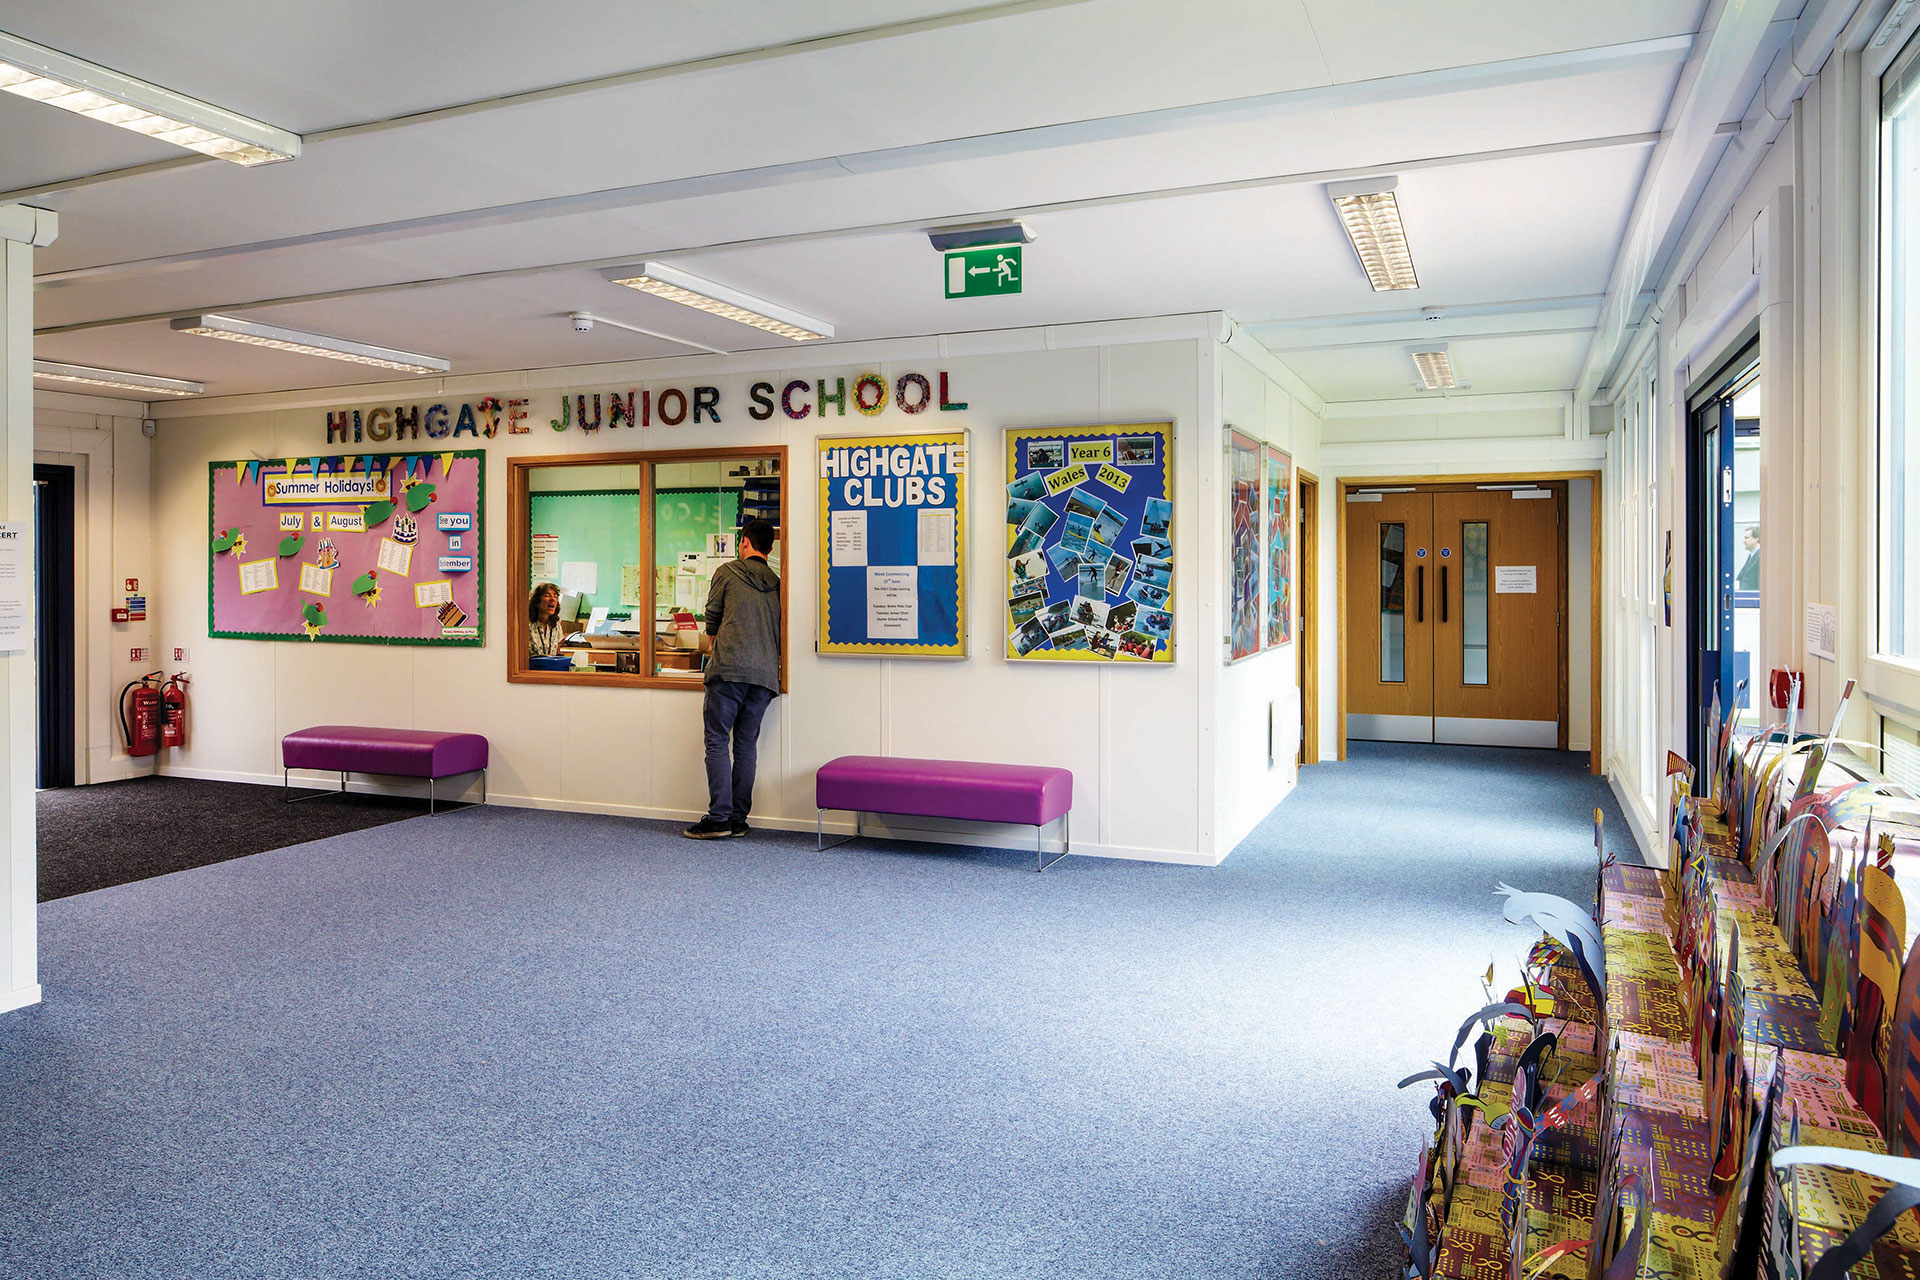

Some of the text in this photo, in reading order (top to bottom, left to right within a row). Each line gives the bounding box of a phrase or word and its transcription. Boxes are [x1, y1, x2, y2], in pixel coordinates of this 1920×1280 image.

[550, 386, 721, 436] JUNIOR
[748, 371, 968, 421] SCHOOL
[1071, 446, 1111, 459] Year 6
[820, 443, 964, 478] HIGHGATE
[1047, 467, 1128, 491] Wales 2013
[275, 479, 375, 495] Summer Holidays!
[843, 476, 946, 508] CLUBS
[281, 515, 362, 529] July & August
[450, 517, 469, 527] you
[0, 531, 18, 539] ERT
[451, 538, 460, 547] in
